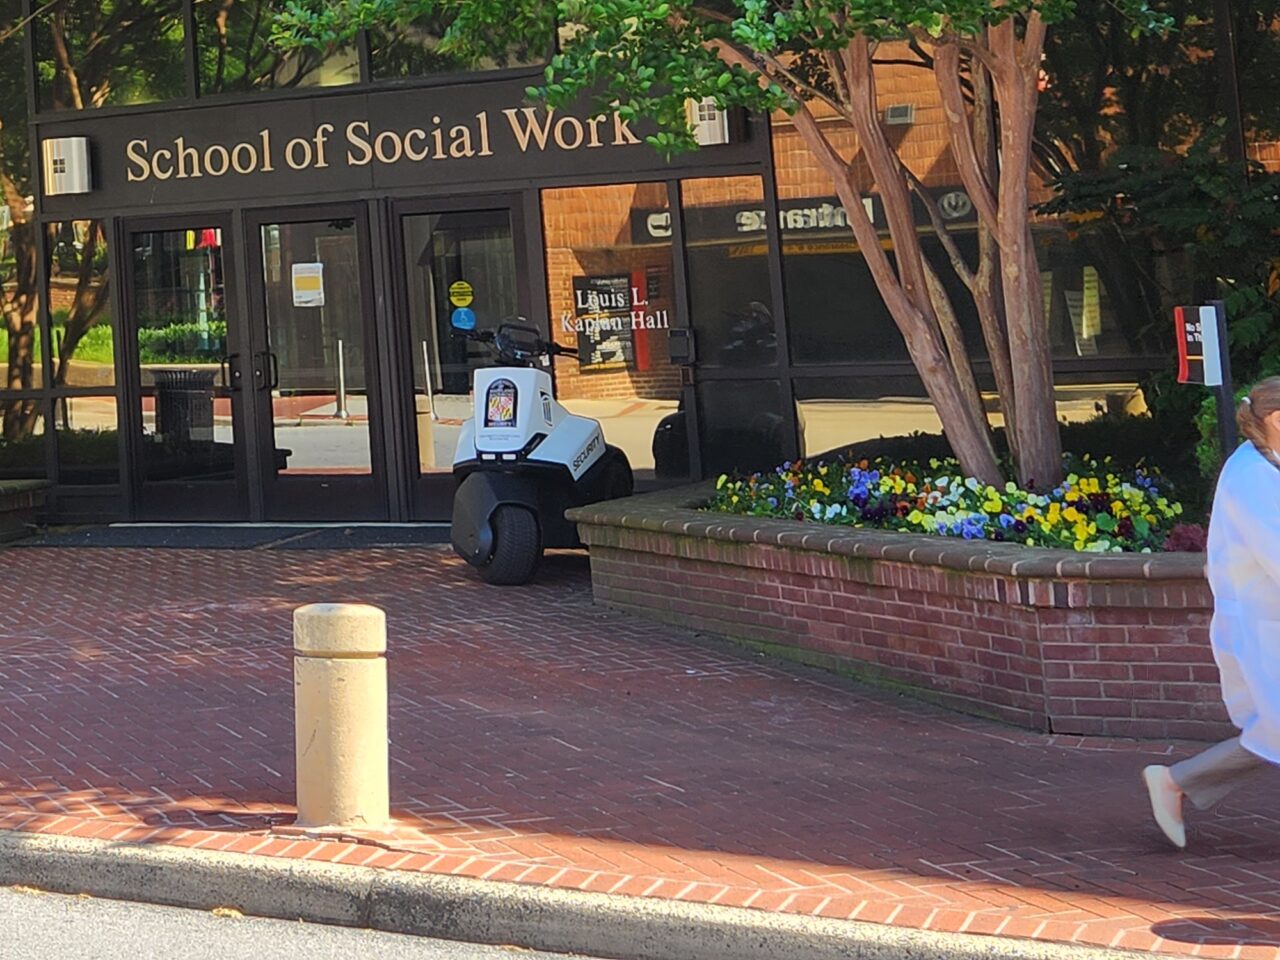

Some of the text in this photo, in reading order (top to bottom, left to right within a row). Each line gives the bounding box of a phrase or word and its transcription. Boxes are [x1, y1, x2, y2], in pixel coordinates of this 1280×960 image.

[126, 99, 642, 182] School of Social Work
[576, 287, 649, 309] Louis L.
[561, 310, 670, 336] Kaplan Hall
[572, 433, 600, 472] SECURITY
